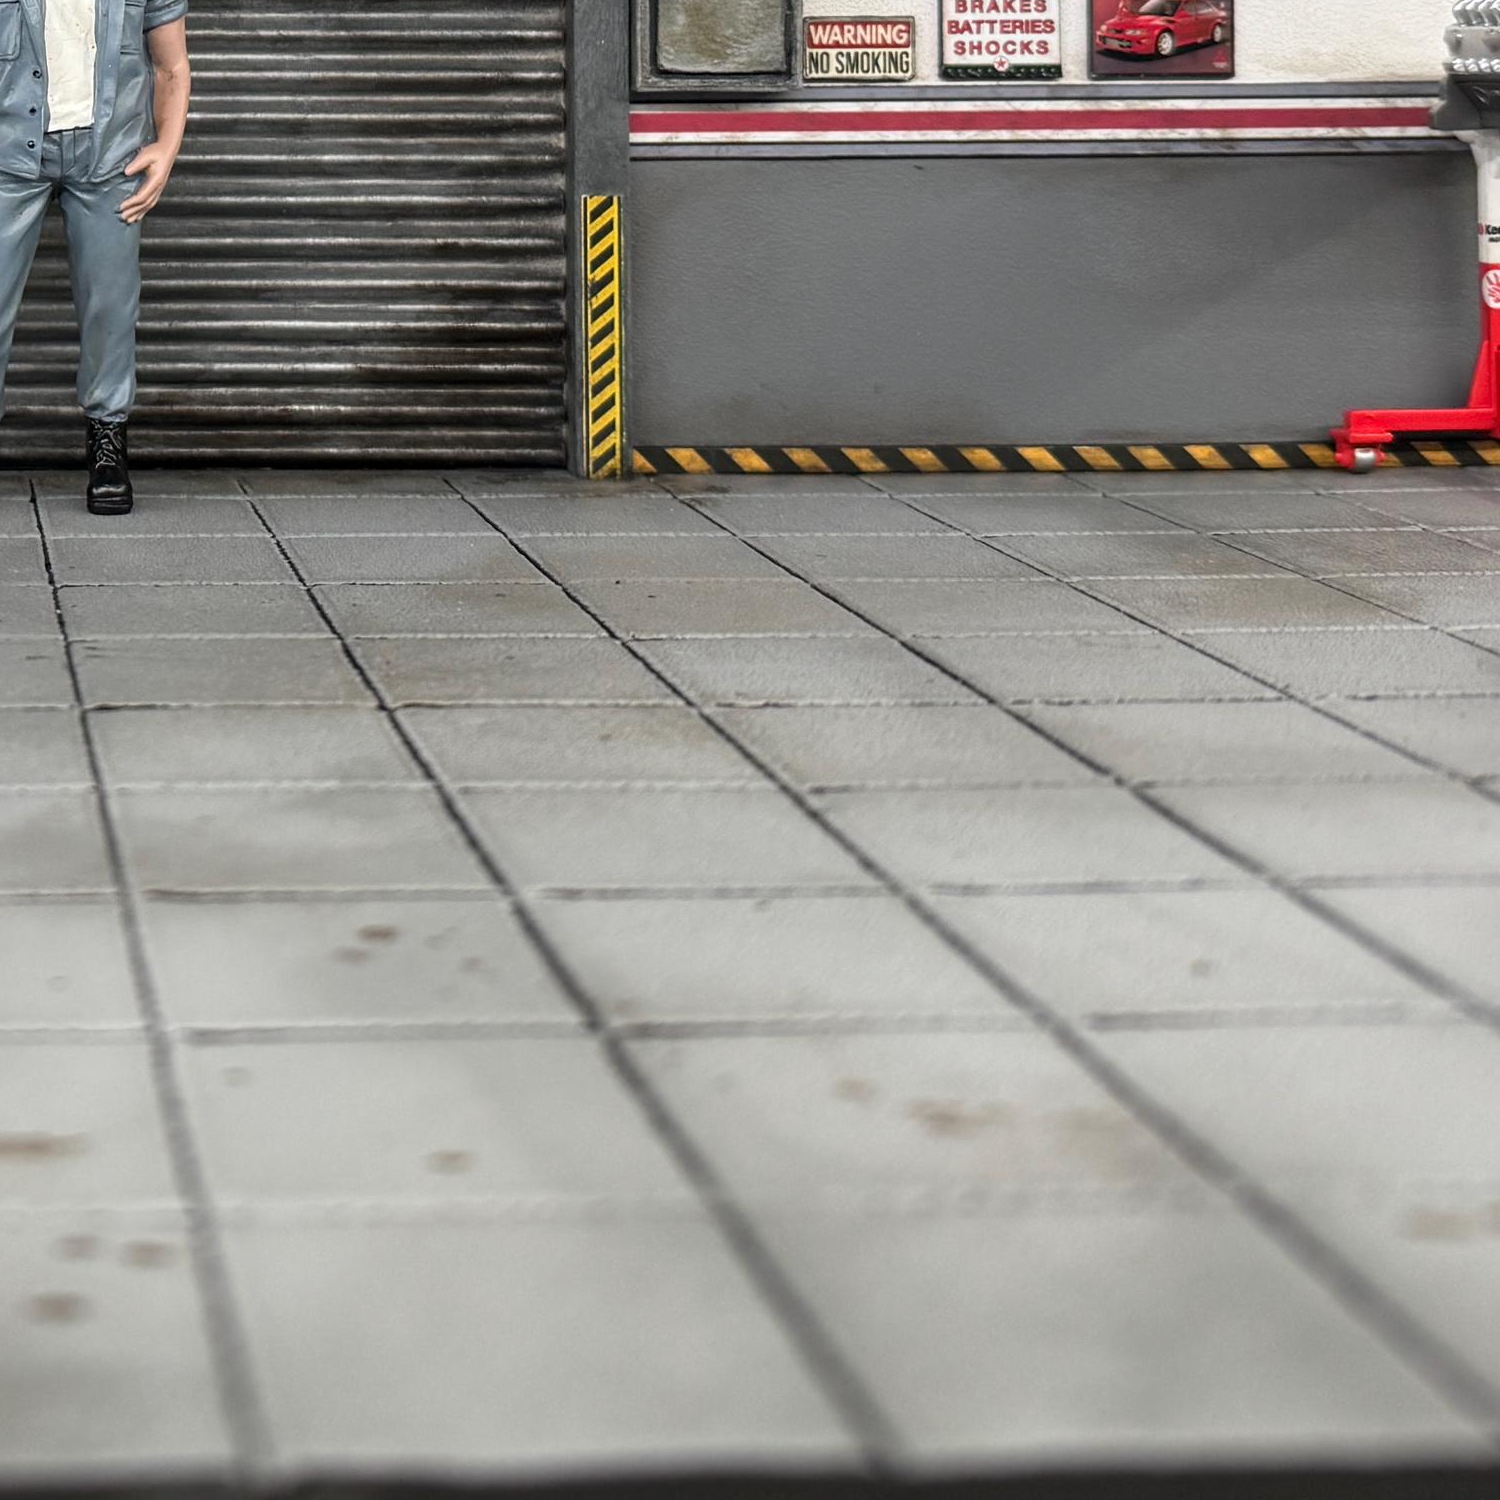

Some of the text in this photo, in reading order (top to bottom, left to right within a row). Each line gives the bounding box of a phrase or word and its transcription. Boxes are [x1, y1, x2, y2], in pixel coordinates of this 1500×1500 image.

[809, 23, 908, 45] WARNING
[947, 19, 1056, 35] BATTERIES
[953, 40, 1050, 56] SHOCKS
[808, 51, 910, 74] NO SMOKING
